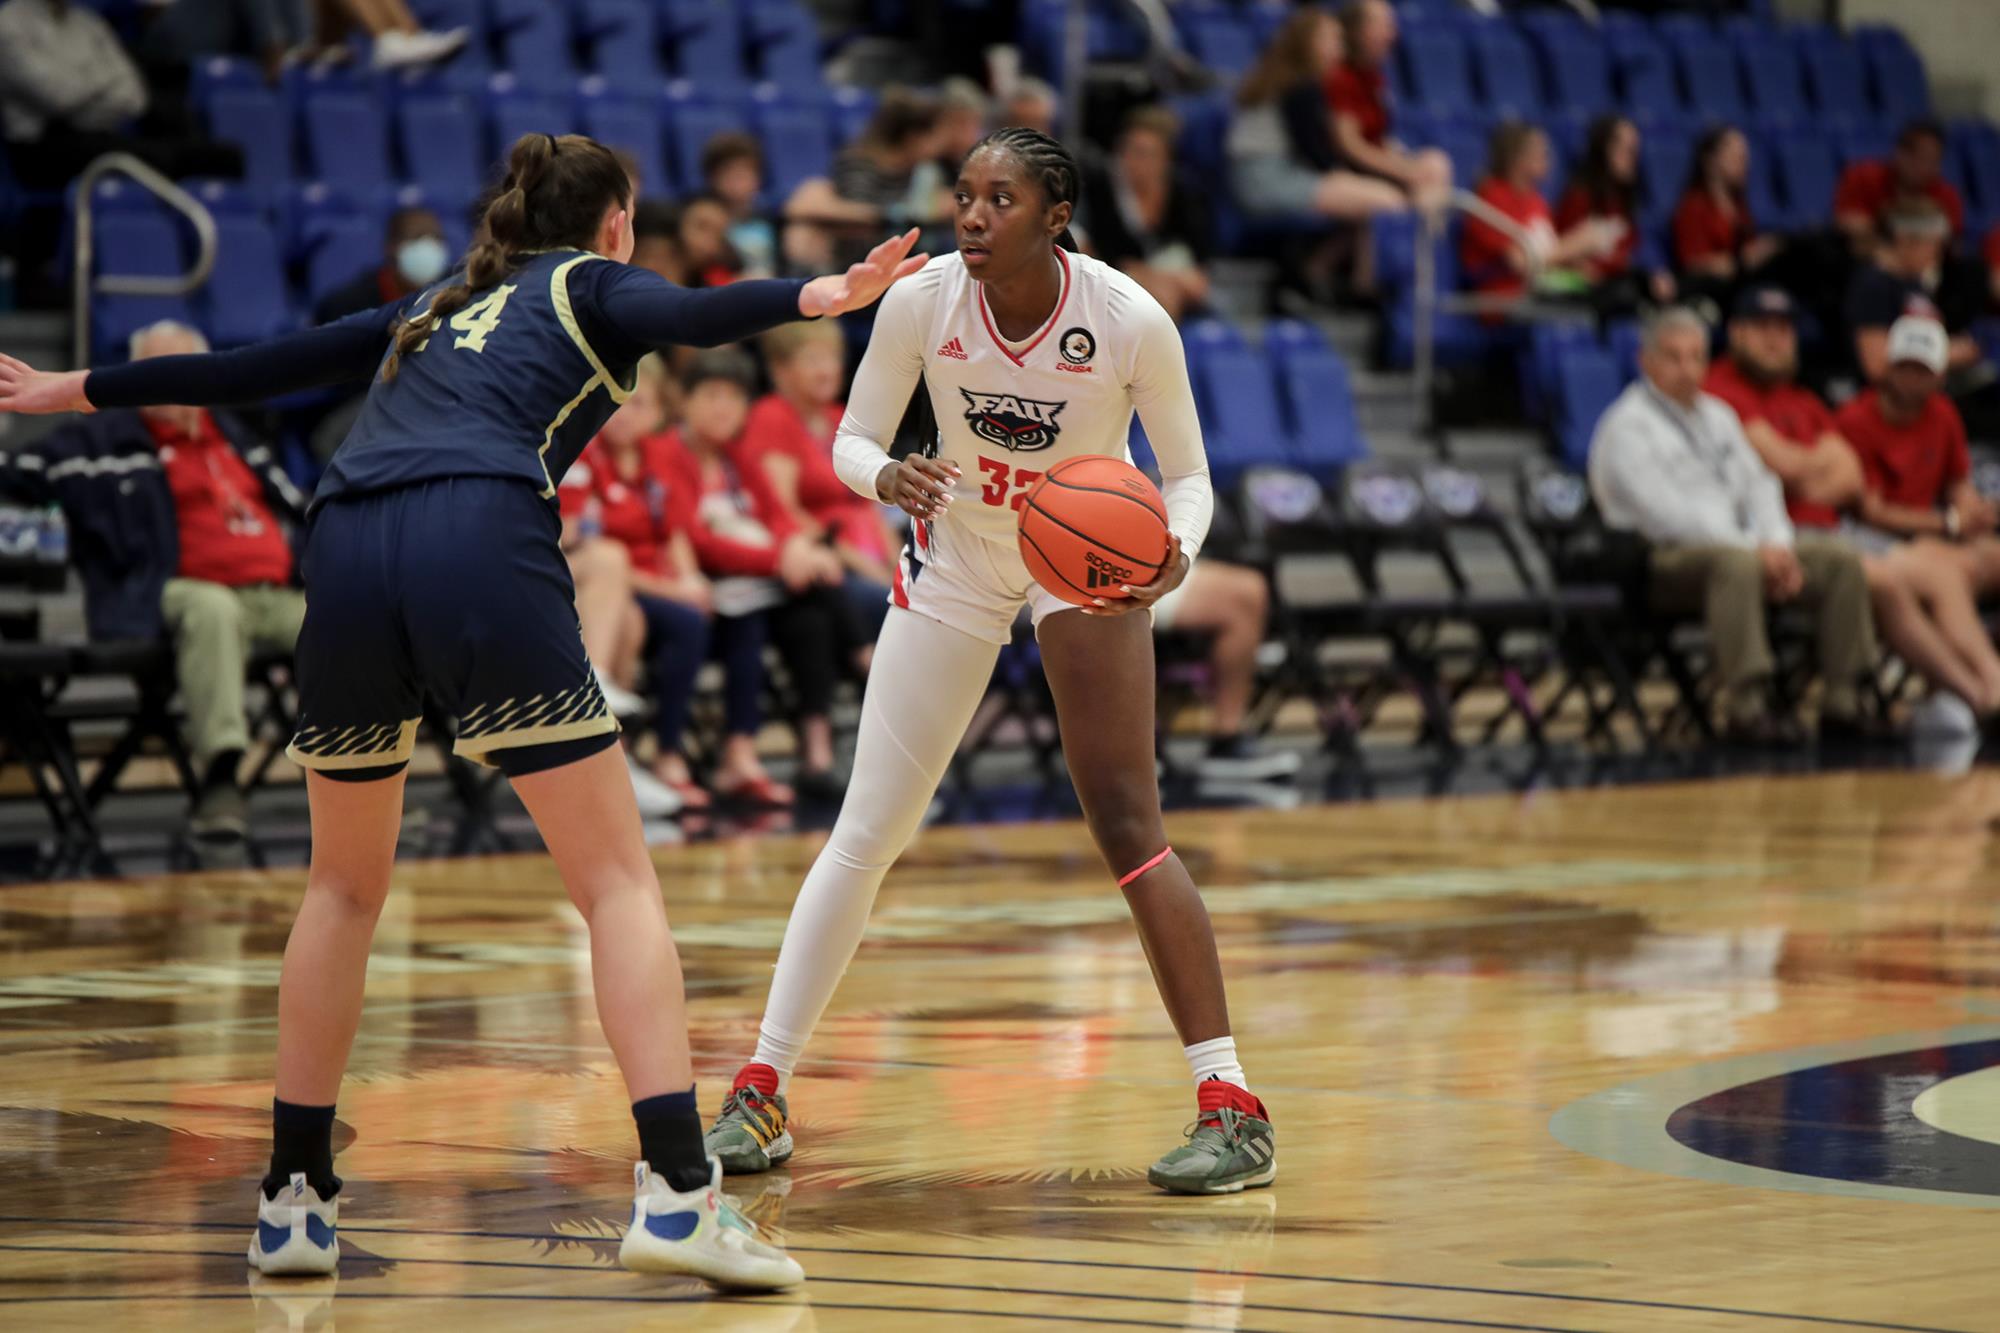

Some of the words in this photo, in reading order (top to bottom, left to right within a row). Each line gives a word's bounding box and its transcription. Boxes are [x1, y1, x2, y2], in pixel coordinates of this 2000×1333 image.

[937, 349, 968, 360] adidas
[1056, 362, 1093, 373] C-USA
[962, 389, 1063, 428] FAU
[1085, 551, 1133, 579] adidas
